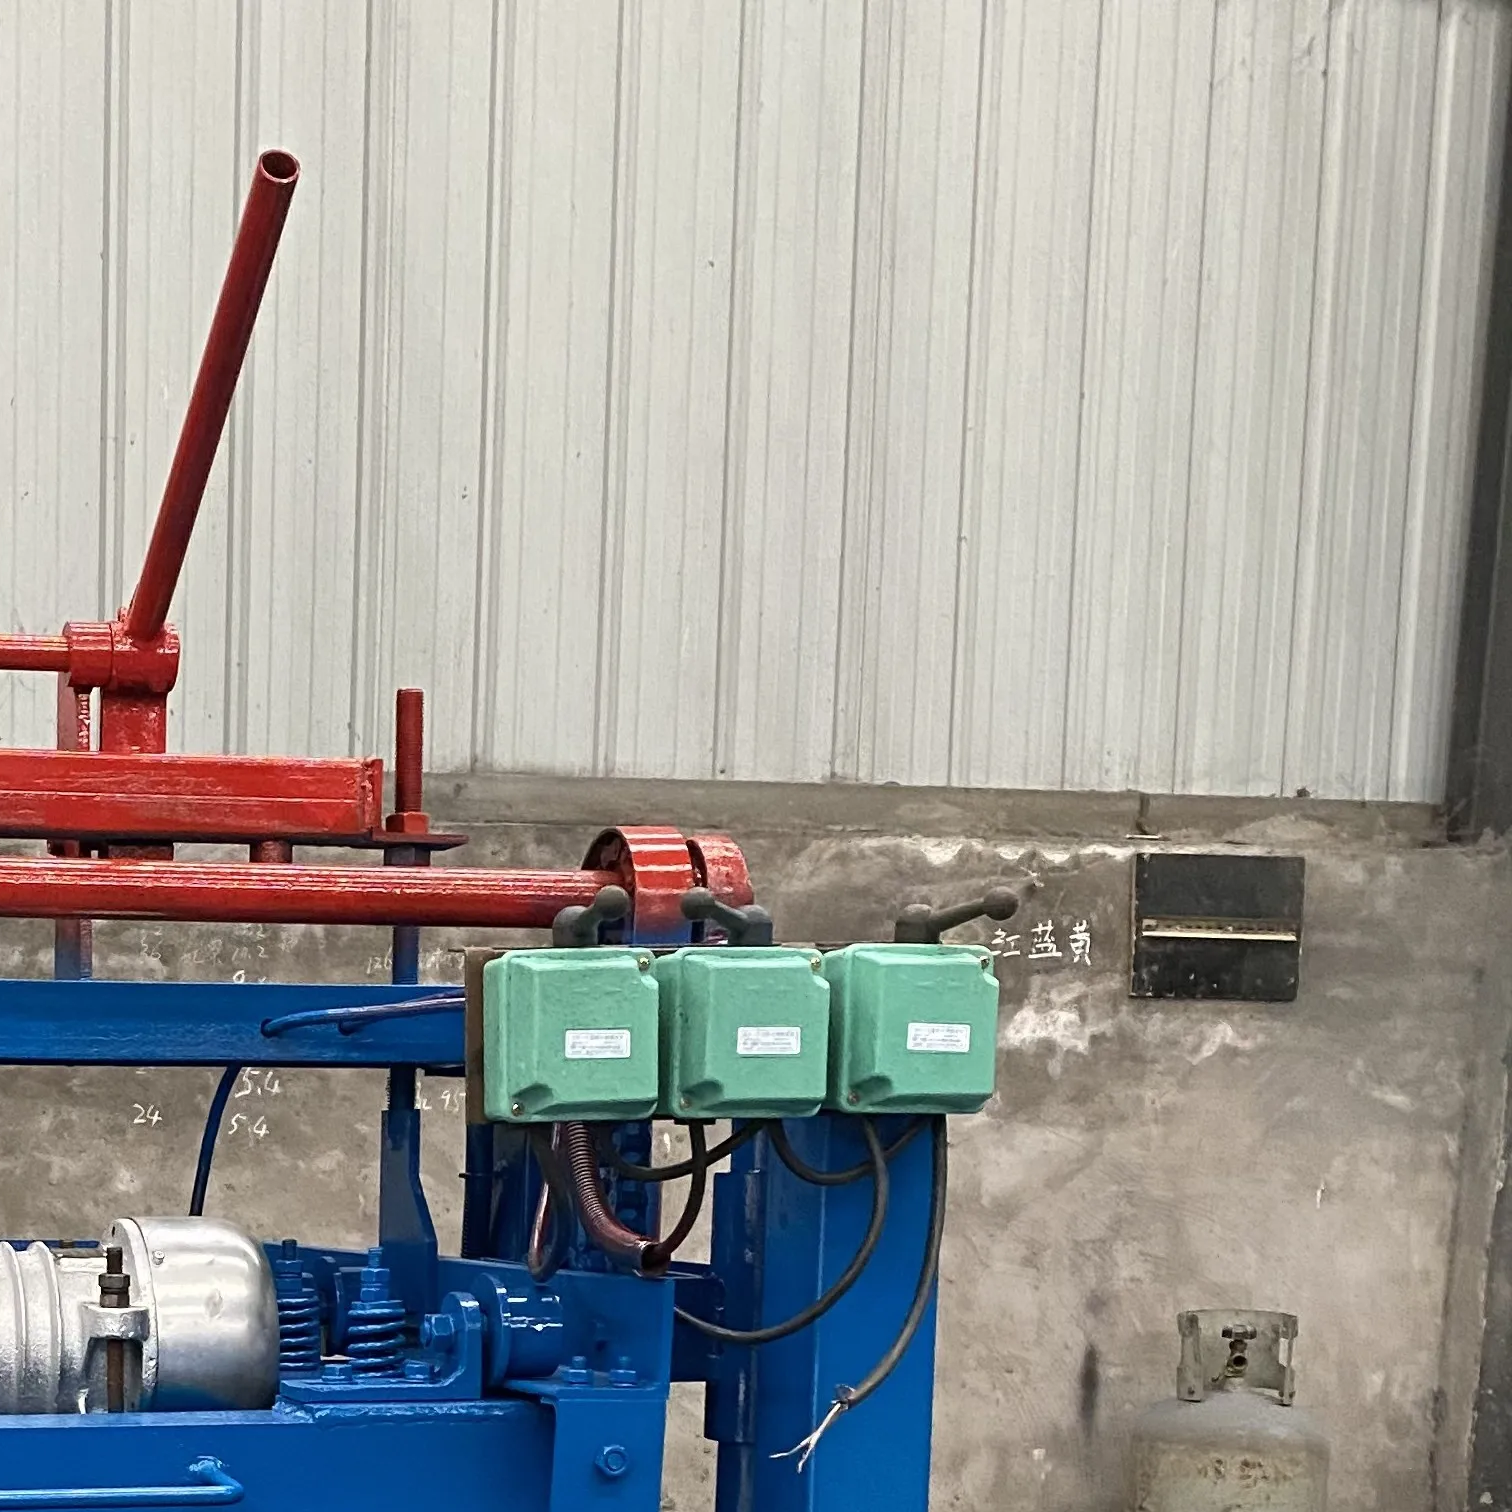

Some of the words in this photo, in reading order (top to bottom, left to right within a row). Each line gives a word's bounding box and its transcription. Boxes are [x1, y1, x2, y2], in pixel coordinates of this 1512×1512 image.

[990, 919, 1092, 967] 红蓝黄
[234, 1067, 281, 1098] 5.4
[132, 1103, 163, 1127] 24
